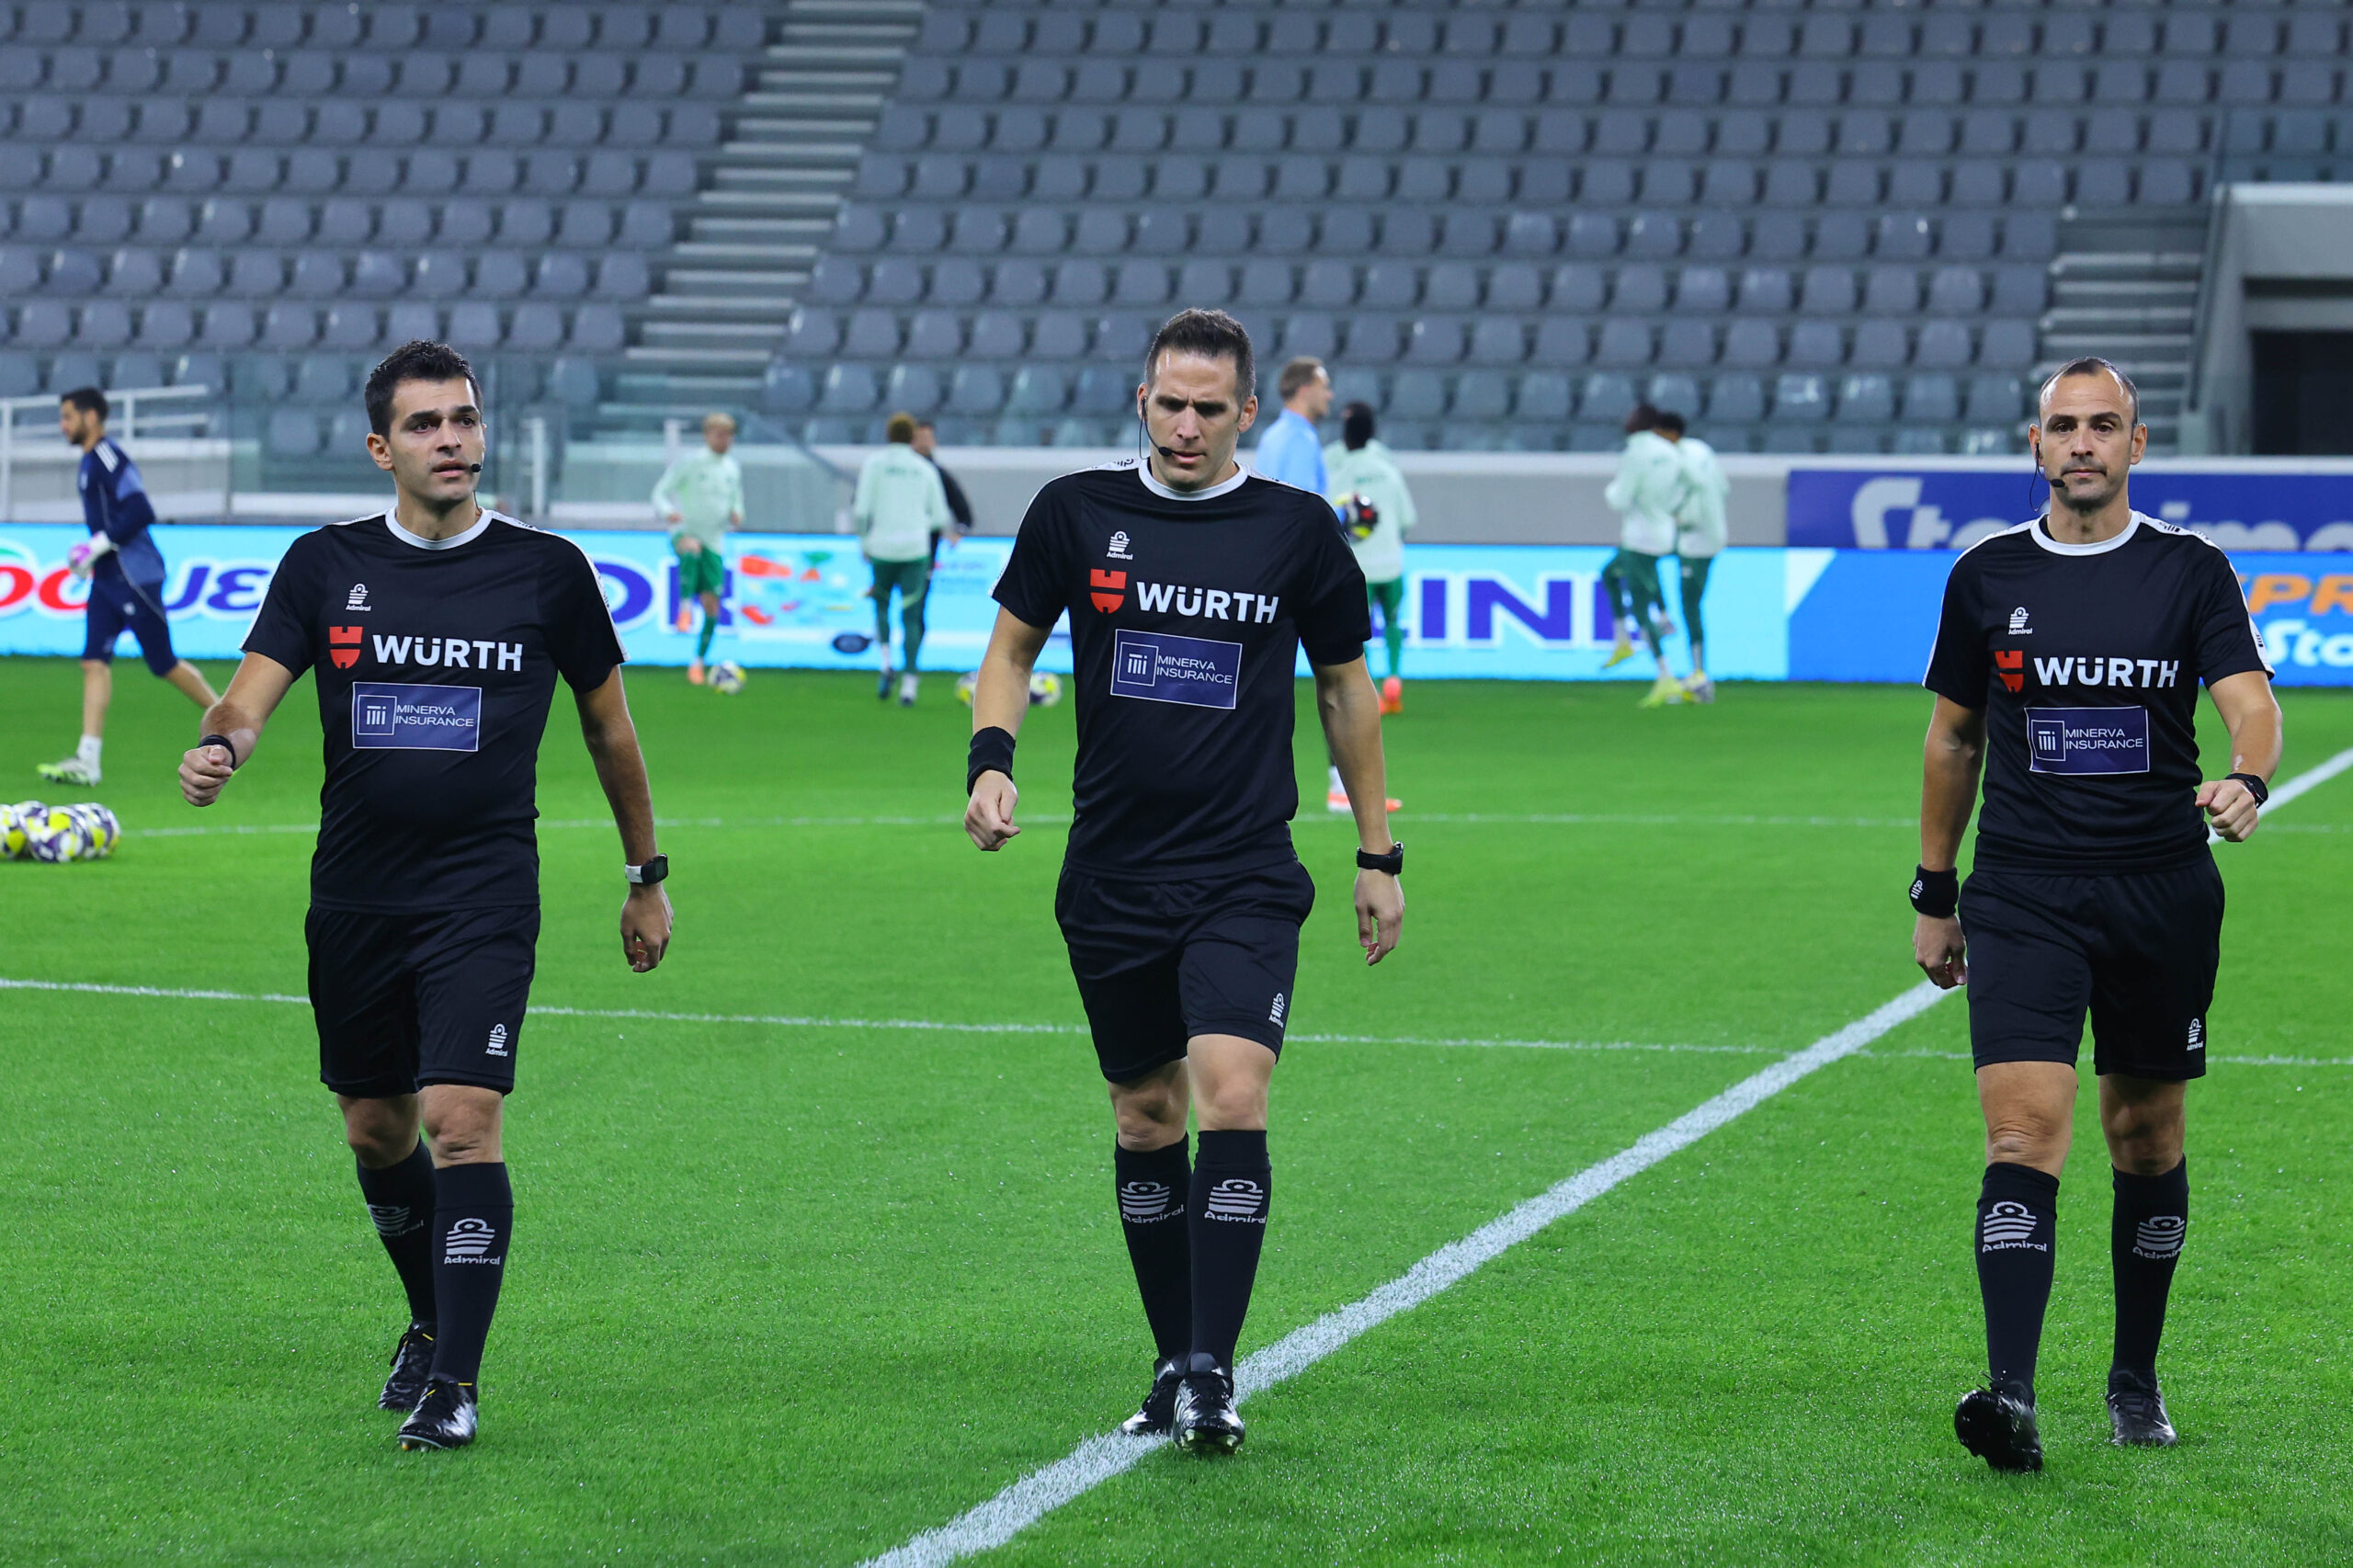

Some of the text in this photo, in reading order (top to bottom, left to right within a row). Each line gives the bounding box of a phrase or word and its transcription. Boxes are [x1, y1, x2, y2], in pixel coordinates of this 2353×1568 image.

[1107, 551, 1133, 560] Admiral
[346, 604, 371, 612] Admiral
[1136, 581, 1279, 624] WÜRTH
[2008, 627, 2033, 635] Admiral
[372, 634, 523, 672] WÜRTH
[1157, 654, 1216, 671] MINERVA
[1156, 666, 1233, 685] INSURANCE
[2033, 656, 2179, 688] WÜRTH
[396, 704, 456, 716] MINERVA
[394, 715, 474, 727] INSURANCE
[2065, 728, 2126, 738] MINERVA
[2065, 738, 2143, 750] INSURANCE
[1121, 1204, 1185, 1224] Admiral
[1204, 1210, 1267, 1225] Admiral
[1982, 1240, 2047, 1254] Admiral
[444, 1255, 501, 1266] Admiral
